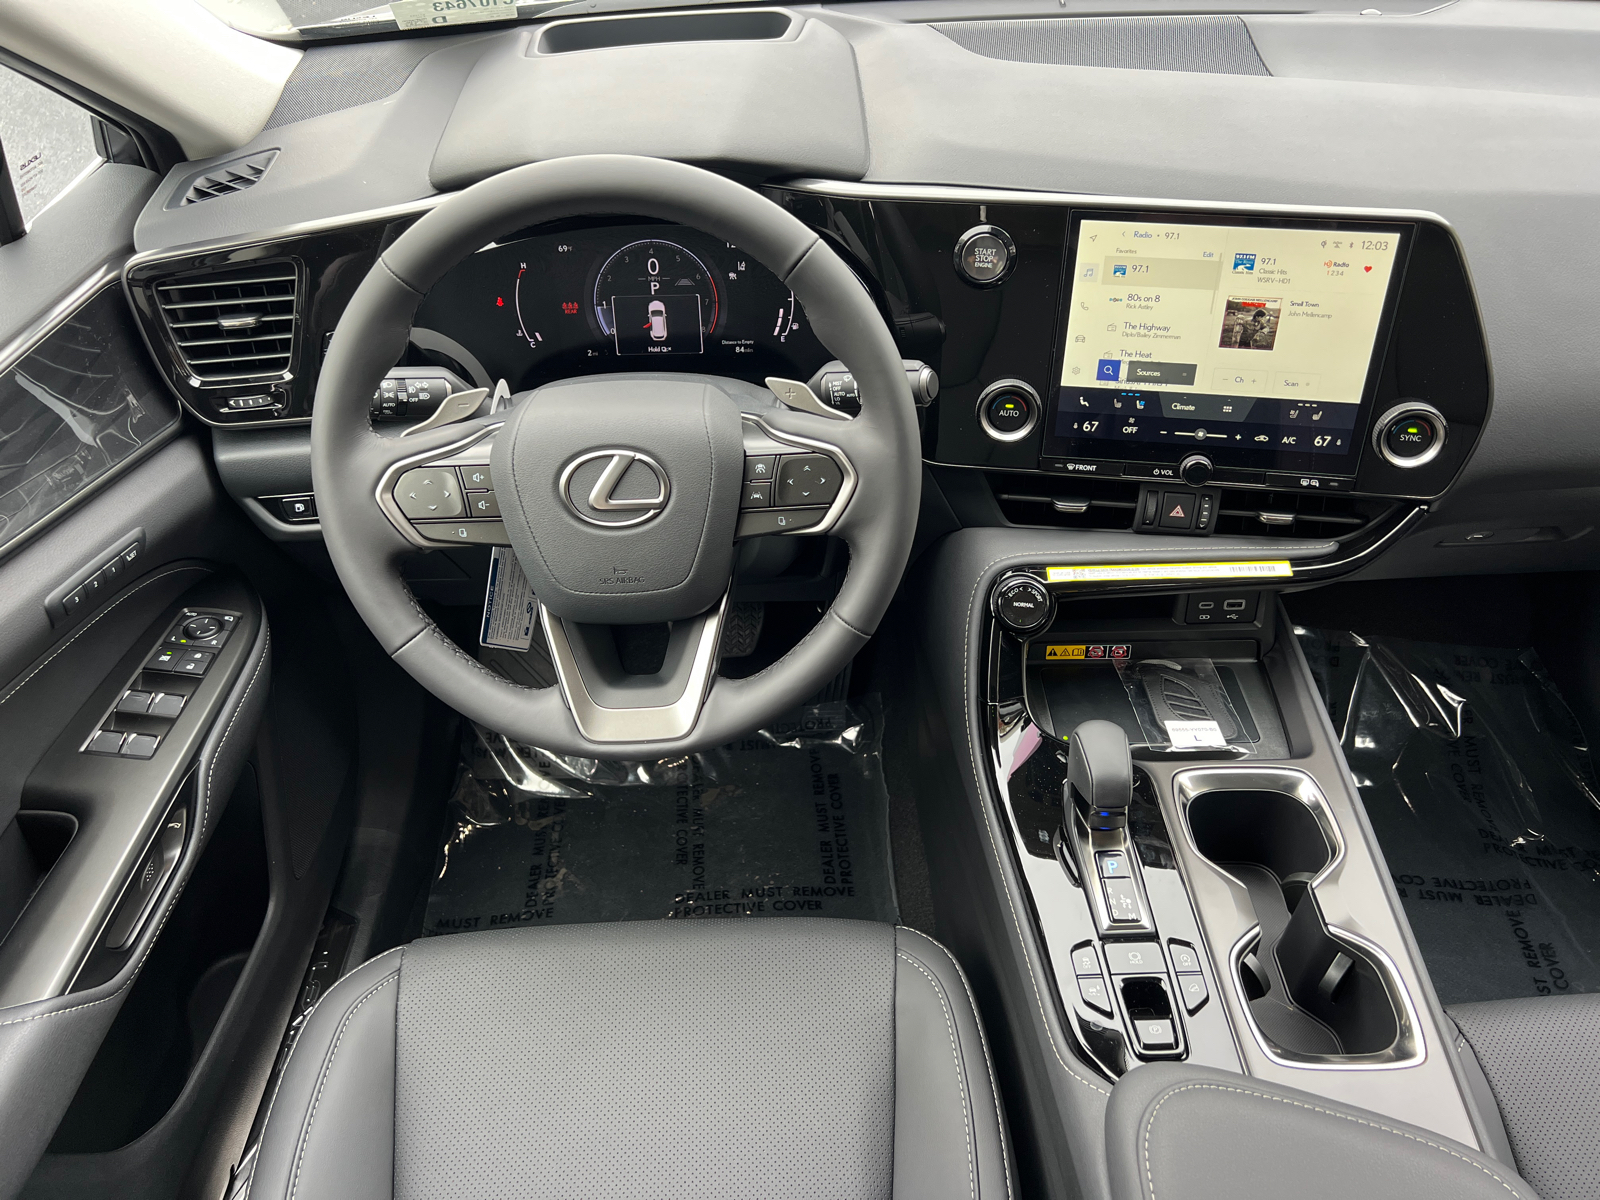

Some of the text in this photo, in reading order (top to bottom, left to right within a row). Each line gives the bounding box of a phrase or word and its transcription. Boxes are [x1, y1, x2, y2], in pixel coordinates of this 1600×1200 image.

[1133, 231, 1180, 240] Radio 97.1
[974, 248, 997, 256] START
[1361, 240, 1389, 251] 12:03
[647, 258, 659, 275] 0
[1131, 264, 1149, 273] 97.1
[1261, 258, 1276, 266] 97.1
[650, 282, 660, 295] P
[1127, 294, 1142, 302] 80s
[1124, 322, 1171, 332] The Highway
[1120, 349, 1152, 359] The Heat
[1136, 368, 1160, 377] Sources
[1234, 376, 1244, 384] Ch
[1172, 402, 1196, 411] Climate
[1082, 421, 1099, 432] 67
[1122, 426, 1138, 434] OFF
[1314, 436, 1331, 447] 67
[1400, 434, 1422, 442] SYNC
[1075, 464, 1097, 472] FRONT
[486, 585, 495, 618] NOTICE
[772, 717, 832, 734] PROTECTI
[1464, 735, 1482, 774] MUST
[551, 798, 566, 832] COVE
[815, 802, 830, 832] MUST
[828, 773, 853, 885] PROTECTIVE COVER
[676, 829, 688, 865] COVER
[692, 844, 705, 890] REMOVE
[820, 840, 836, 884] DEALER
[1107, 860, 1118, 874] P
[524, 864, 543, 908] DEALER
[1432, 877, 1532, 892] PROTECTIVE
[674, 886, 854, 904] DEALER MUST REMOVE
[1419, 888, 1462, 902] MUST
[1474, 894, 1538, 906] DEALER
[674, 900, 823, 918] PROTECTIVE COVER
[436, 907, 554, 929] MUST REMOVE
[1506, 910, 1552, 996] ST REMOVE
[1538, 942, 1569, 991] COVER
